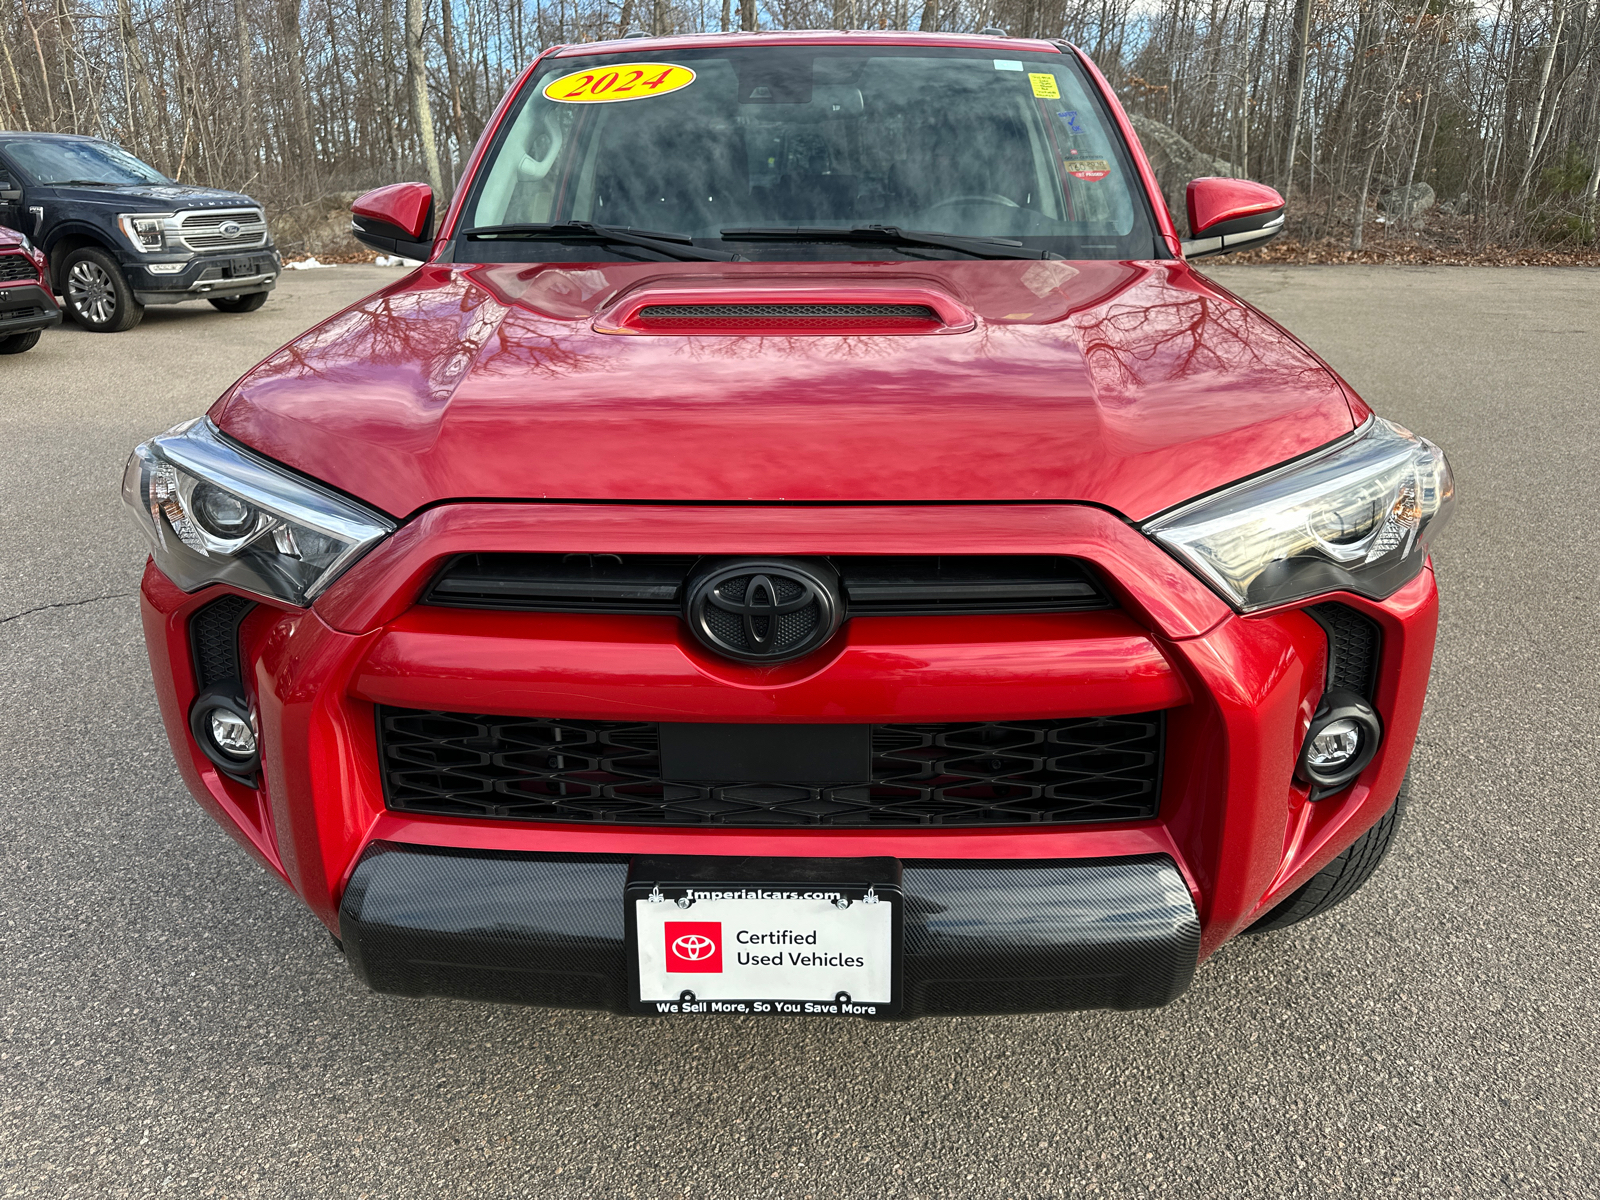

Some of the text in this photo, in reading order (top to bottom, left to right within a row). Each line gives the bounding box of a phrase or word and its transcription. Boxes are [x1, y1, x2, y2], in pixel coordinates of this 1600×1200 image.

[563, 67, 675, 98] 2024
[686, 889, 841, 901] Imperialcars.com
[736, 930, 817, 945] Certified
[737, 952, 864, 967] Used Vehicles
[656, 1002, 876, 1015] We Sell More, So You Save More
